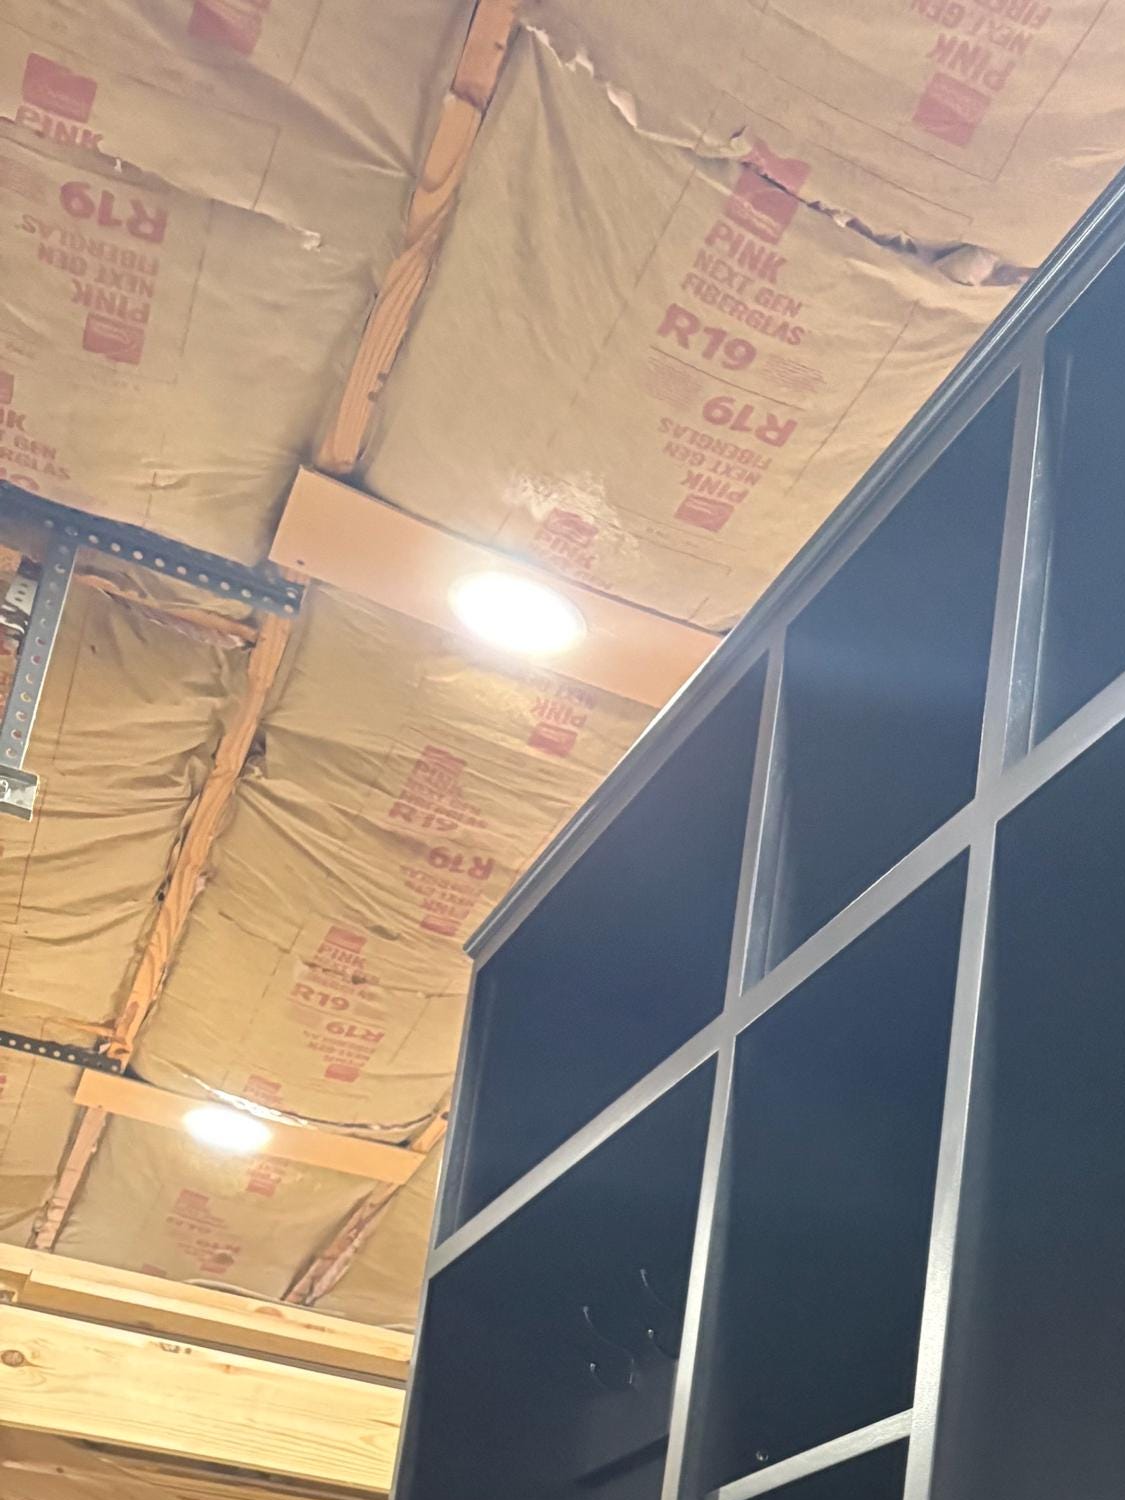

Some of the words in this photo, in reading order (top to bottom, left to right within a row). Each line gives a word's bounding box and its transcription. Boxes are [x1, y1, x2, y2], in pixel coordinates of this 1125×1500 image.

[925, 32, 1016, 92] PINK
[60, 180, 169, 244] R19
[704, 219, 788, 284] PINK
[71, 278, 151, 324] PINK
[680, 271, 806, 346] FIBERGLAS
[692, 248, 753, 295] NEXT
[755, 286, 803, 319] GEN
[656, 302, 758, 371] R19
[657, 416, 773, 471] FIBERGLAS
[702, 395, 798, 448] R19
[679, 469, 749, 505] PINK
[707, 459, 762, 487] NEXT
[388, 800, 459, 833] R19
[427, 845, 497, 881] R19
[291, 982, 350, 1012] R19
[326, 1021, 385, 1042] R19
